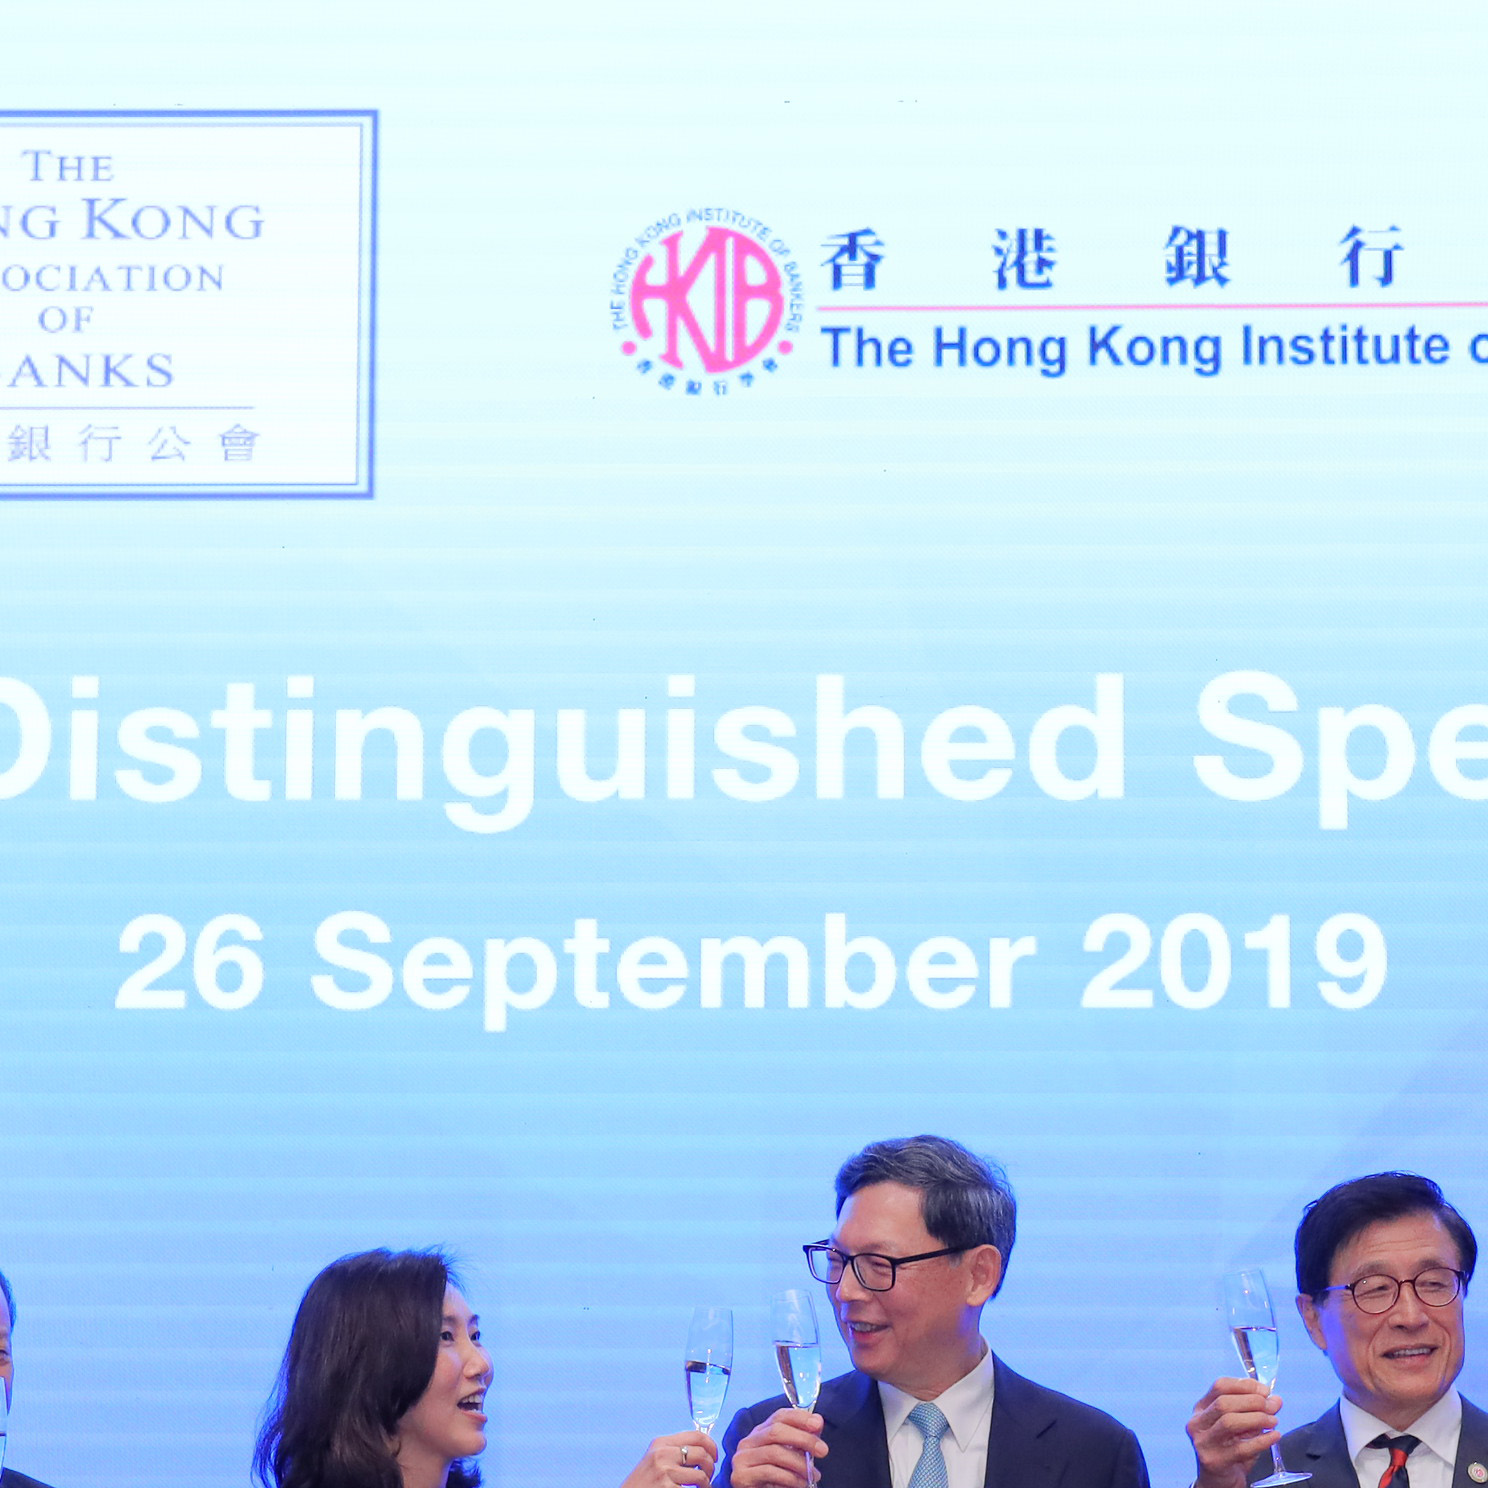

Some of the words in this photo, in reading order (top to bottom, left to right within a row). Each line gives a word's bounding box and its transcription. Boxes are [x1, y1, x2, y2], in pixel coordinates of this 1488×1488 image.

[22, 149, 114, 182] THE
[81, 197, 265, 241] KONG
[37, 305, 95, 334] OF
[820, 325, 914, 368] The
[934, 325, 1067, 379] Hong
[1089, 324, 1222, 378] Kong
[1242, 322, 1450, 366] Institute
[114, 913, 265, 1011] 26
[311, 911, 1038, 1033] September
[1081, 912, 1388, 1010] 2019
